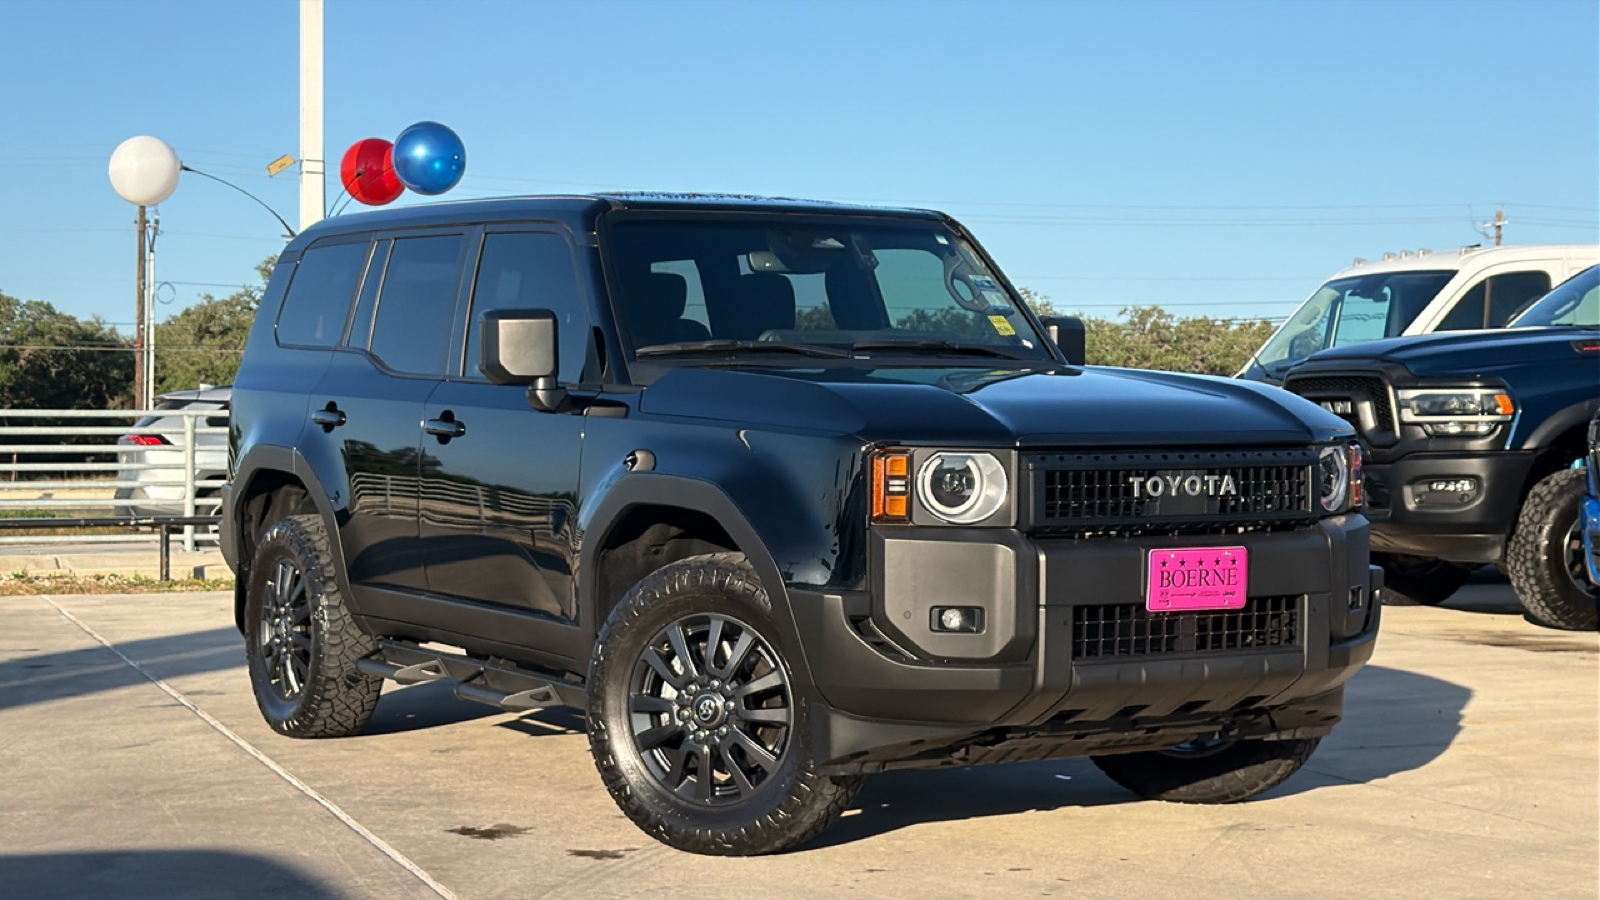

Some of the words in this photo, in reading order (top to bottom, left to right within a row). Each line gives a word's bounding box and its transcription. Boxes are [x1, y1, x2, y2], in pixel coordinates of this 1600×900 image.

[1320, 401, 1352, 415] AM
[1129, 474, 1237, 497] TOYOTA
[1160, 568, 1239, 588] BOERNE
